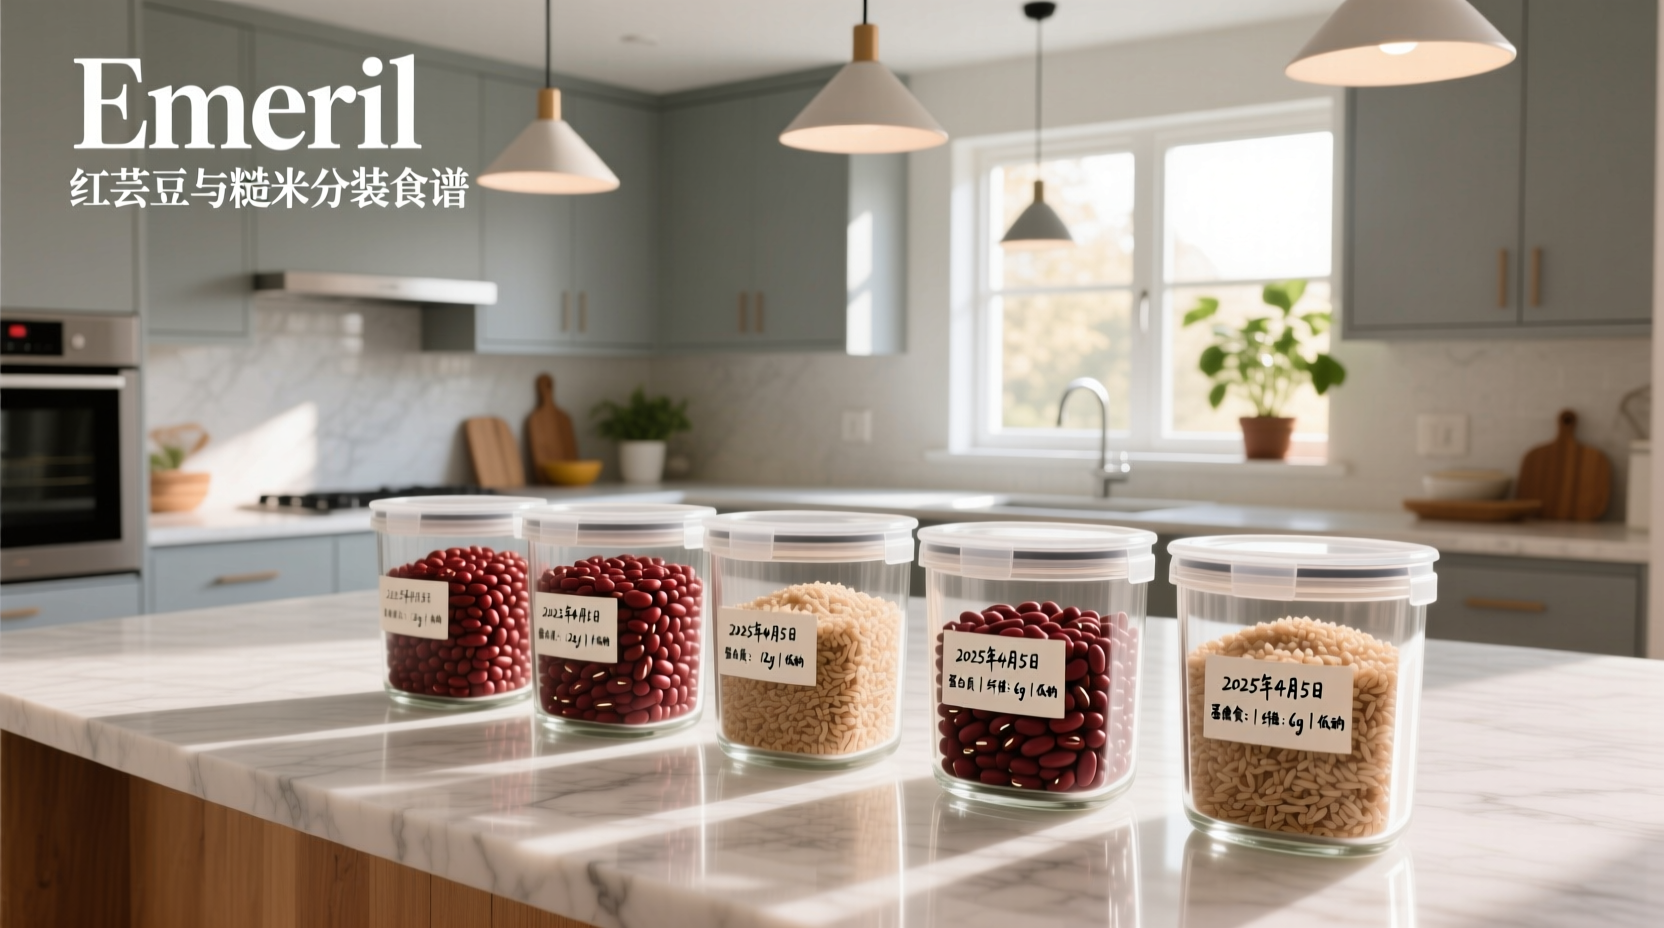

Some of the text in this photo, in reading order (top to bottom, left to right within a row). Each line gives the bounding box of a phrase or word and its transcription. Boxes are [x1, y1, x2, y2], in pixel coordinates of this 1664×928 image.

[956, 646, 1039, 672] 2025年4月5日
[1222, 673, 1323, 701] 2025年4月5日
[1289, 712, 1304, 736] 6g
